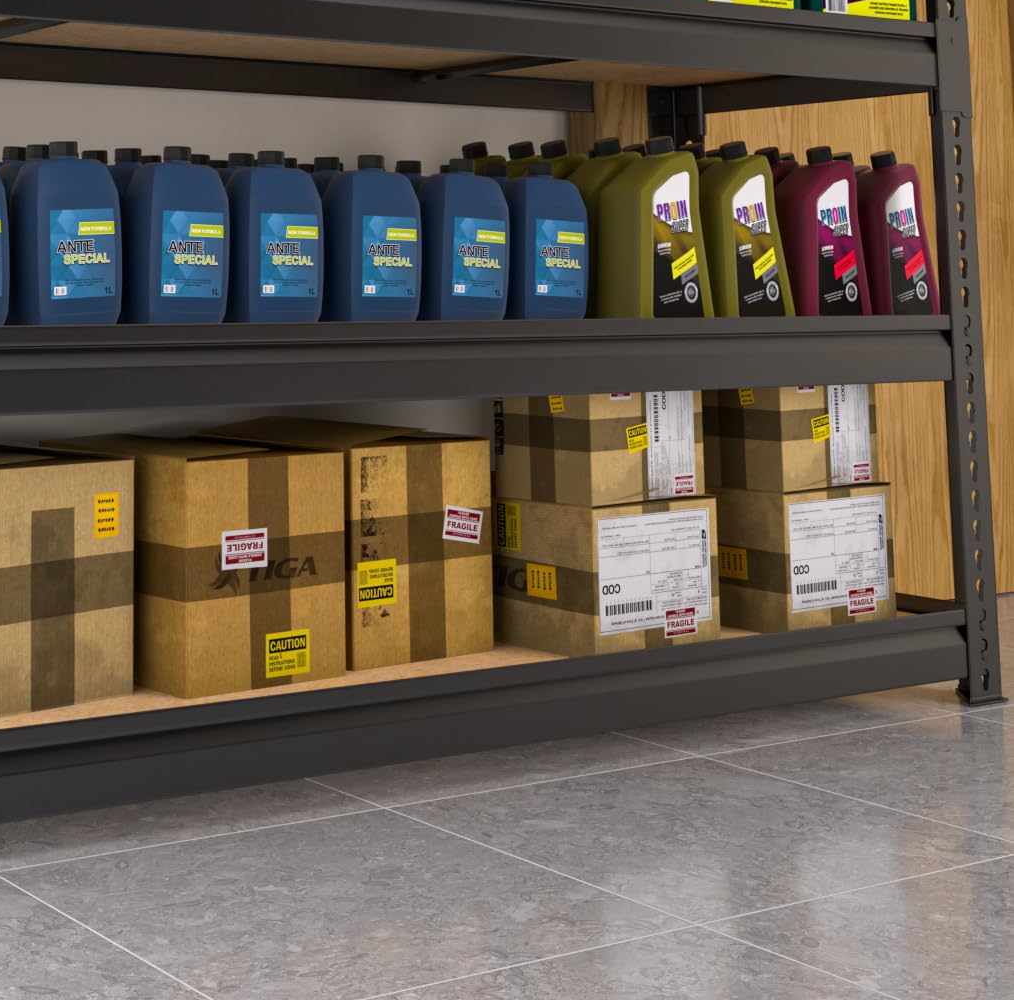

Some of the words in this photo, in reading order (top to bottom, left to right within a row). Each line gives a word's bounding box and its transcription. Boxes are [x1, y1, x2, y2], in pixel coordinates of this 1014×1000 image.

[656, 200, 688, 221] PROIN
[736, 202, 766, 224] PROIN
[820, 205, 848, 226] PROIN
[889, 208, 914, 229] PROIN
[56, 239, 95, 254] ANTE
[167, 240, 204, 254] ANTE
[266, 241, 300, 255] ANTE
[368, 243, 400, 257] ANTE
[458, 243, 489, 258] ANTE
[540, 245, 570, 259] ANTE
[63, 253, 111, 265] SPECIAL
[174, 253, 218, 266] SPECIAL
[272, 254, 314, 267] SPECIAL
[373, 256, 413, 268] SPECIAL
[463, 257, 501, 269] SPECIAL
[545, 258, 581, 270] SPECIAL
[447, 520, 478, 532] FRAGILE
[226, 541, 264, 552] FRAGILE
[793, 564, 810, 575] COD
[359, 586, 394, 600] CAUTION
[602, 583, 621, 595] COD
[850, 597, 874, 607] FRAGILE
[667, 618, 695, 629] FRAGILE
[270, 637, 306, 651] CAUTION
